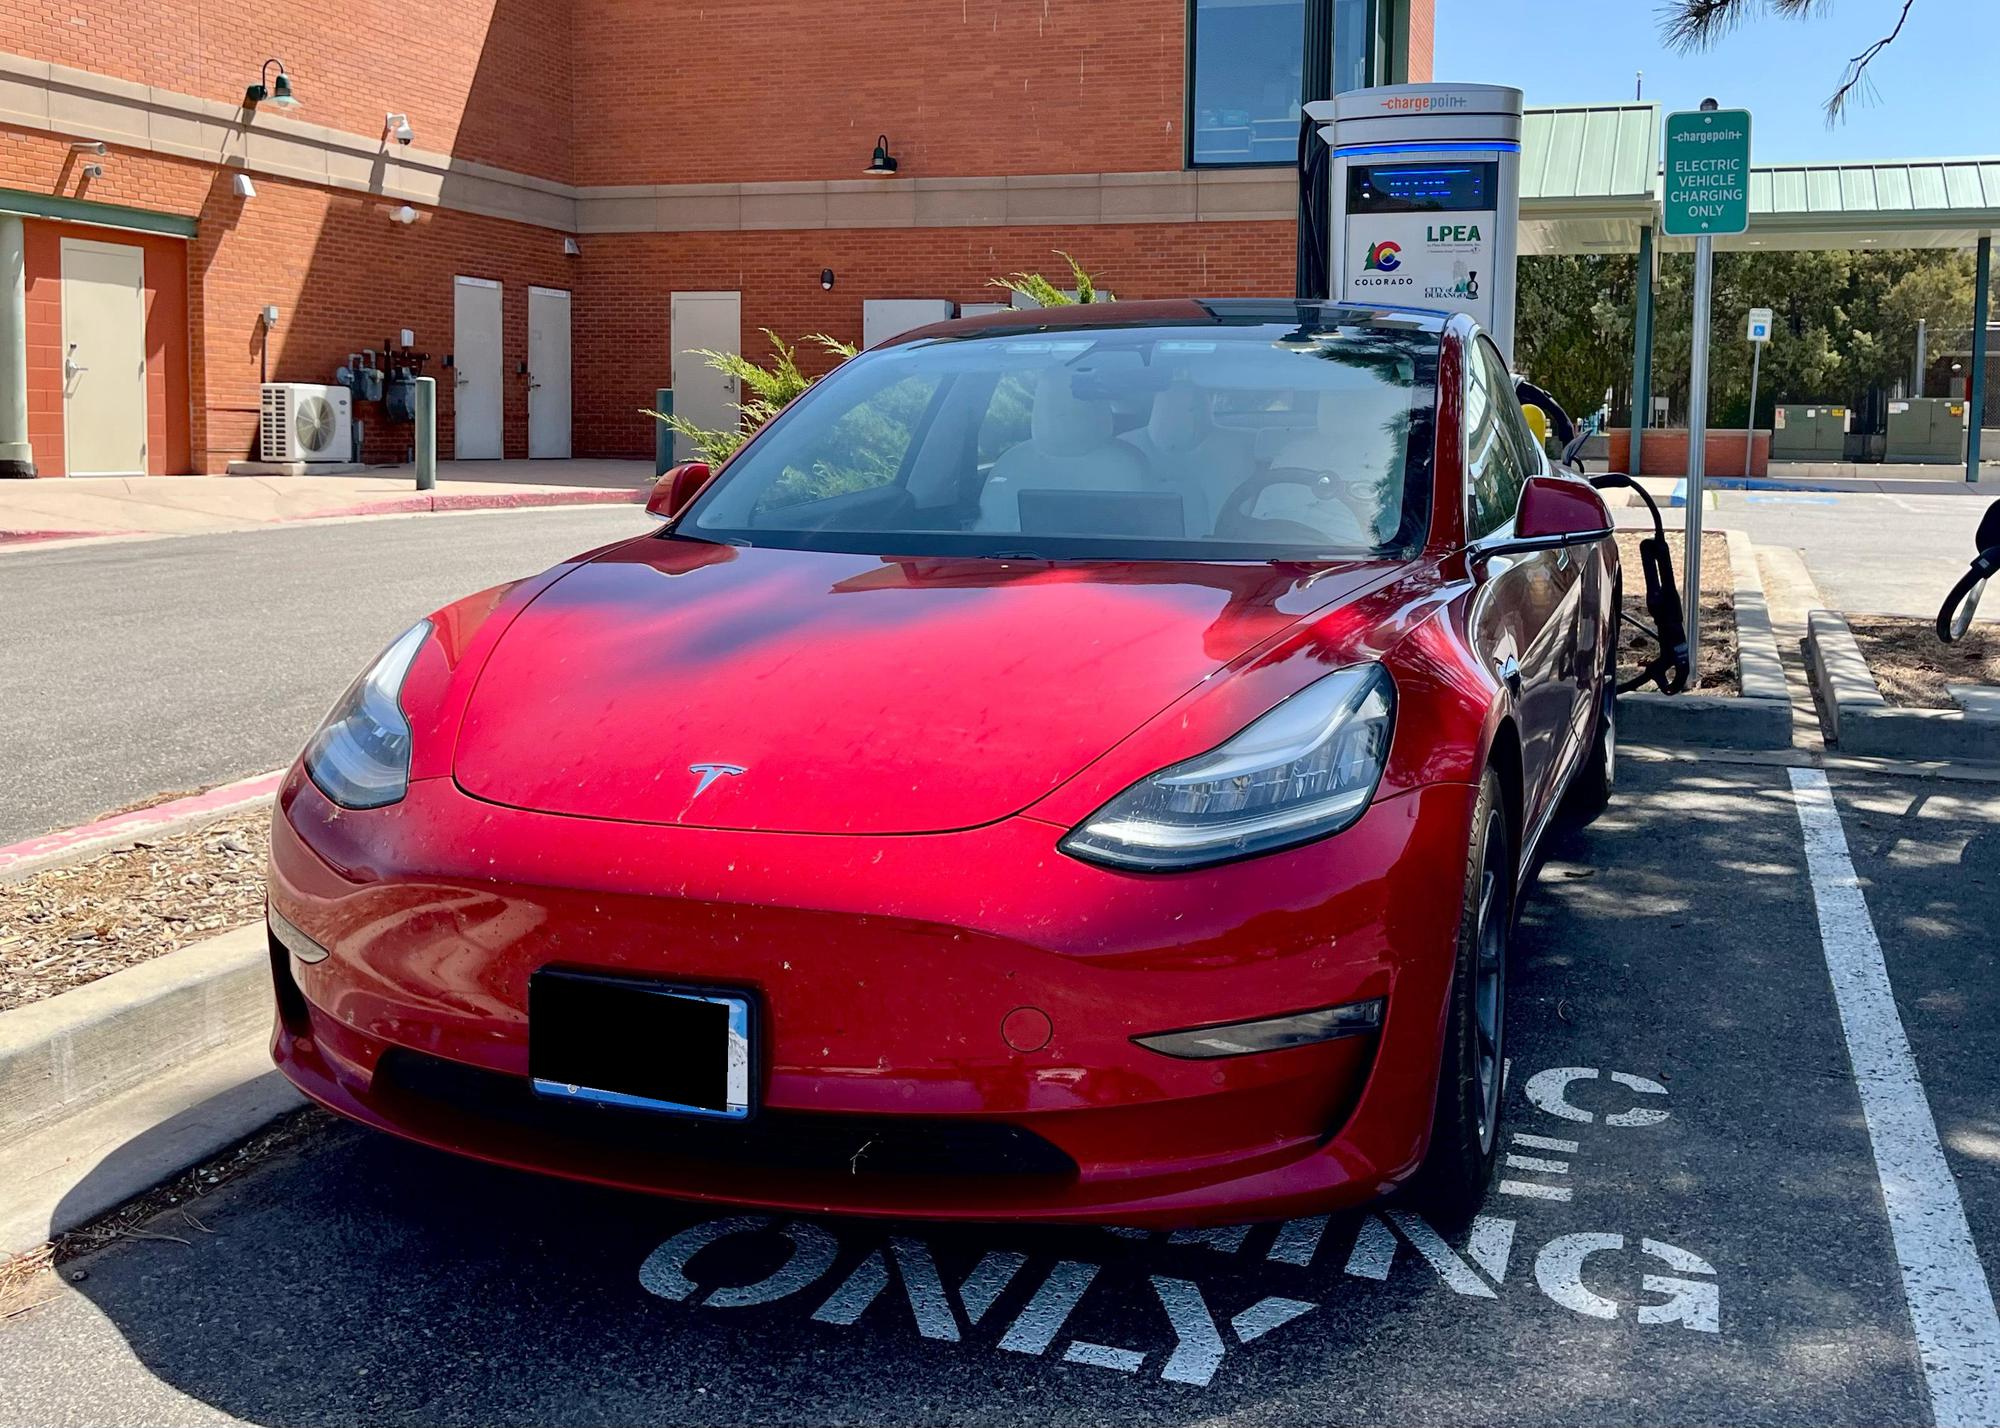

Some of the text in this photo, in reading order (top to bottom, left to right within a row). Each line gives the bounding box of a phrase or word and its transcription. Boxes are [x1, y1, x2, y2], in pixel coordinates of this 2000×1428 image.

[1675, 158, 1740, 173] ELECTRIC
[1679, 174, 1736, 187] VEHICLE
[1670, 189, 1743, 203] CHARGING
[1688, 204, 1724, 217] ONLY
[1427, 225, 1481, 242] LPEA
[1354, 277, 1413, 286] COLORADO
[638, 1215, 1318, 1387] ONLY
